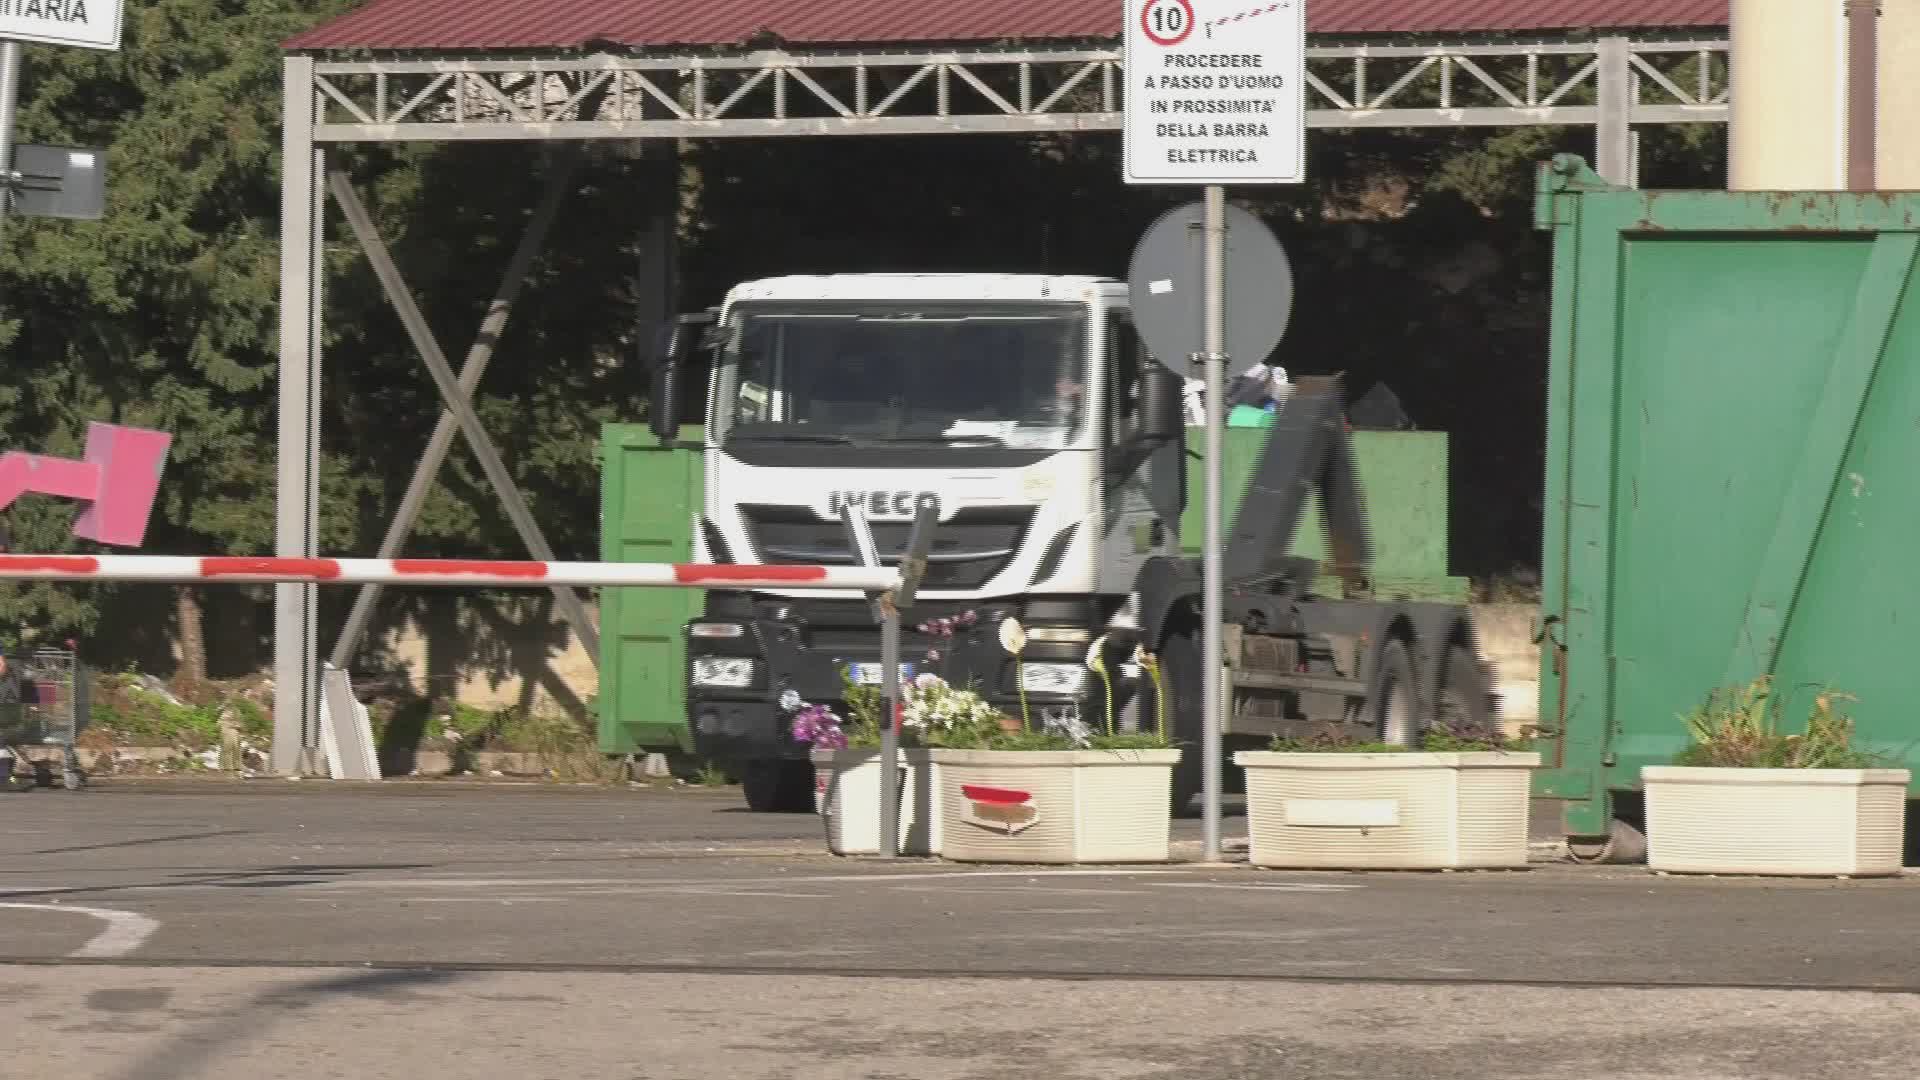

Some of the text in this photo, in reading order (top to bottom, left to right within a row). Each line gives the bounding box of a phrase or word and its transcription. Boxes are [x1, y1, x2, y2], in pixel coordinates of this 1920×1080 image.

[0, 0, 88, 23] ITARIA
[1153, 7, 1182, 31] 10
[1164, 54, 1263, 68] PROCEDERE
[1144, 75, 1284, 89] A PASSO D'UOMO
[1150, 100, 1168, 113] IN
[1156, 123, 1269, 137] DELLA BARRA
[1167, 149, 1258, 163] ELETTRICA
